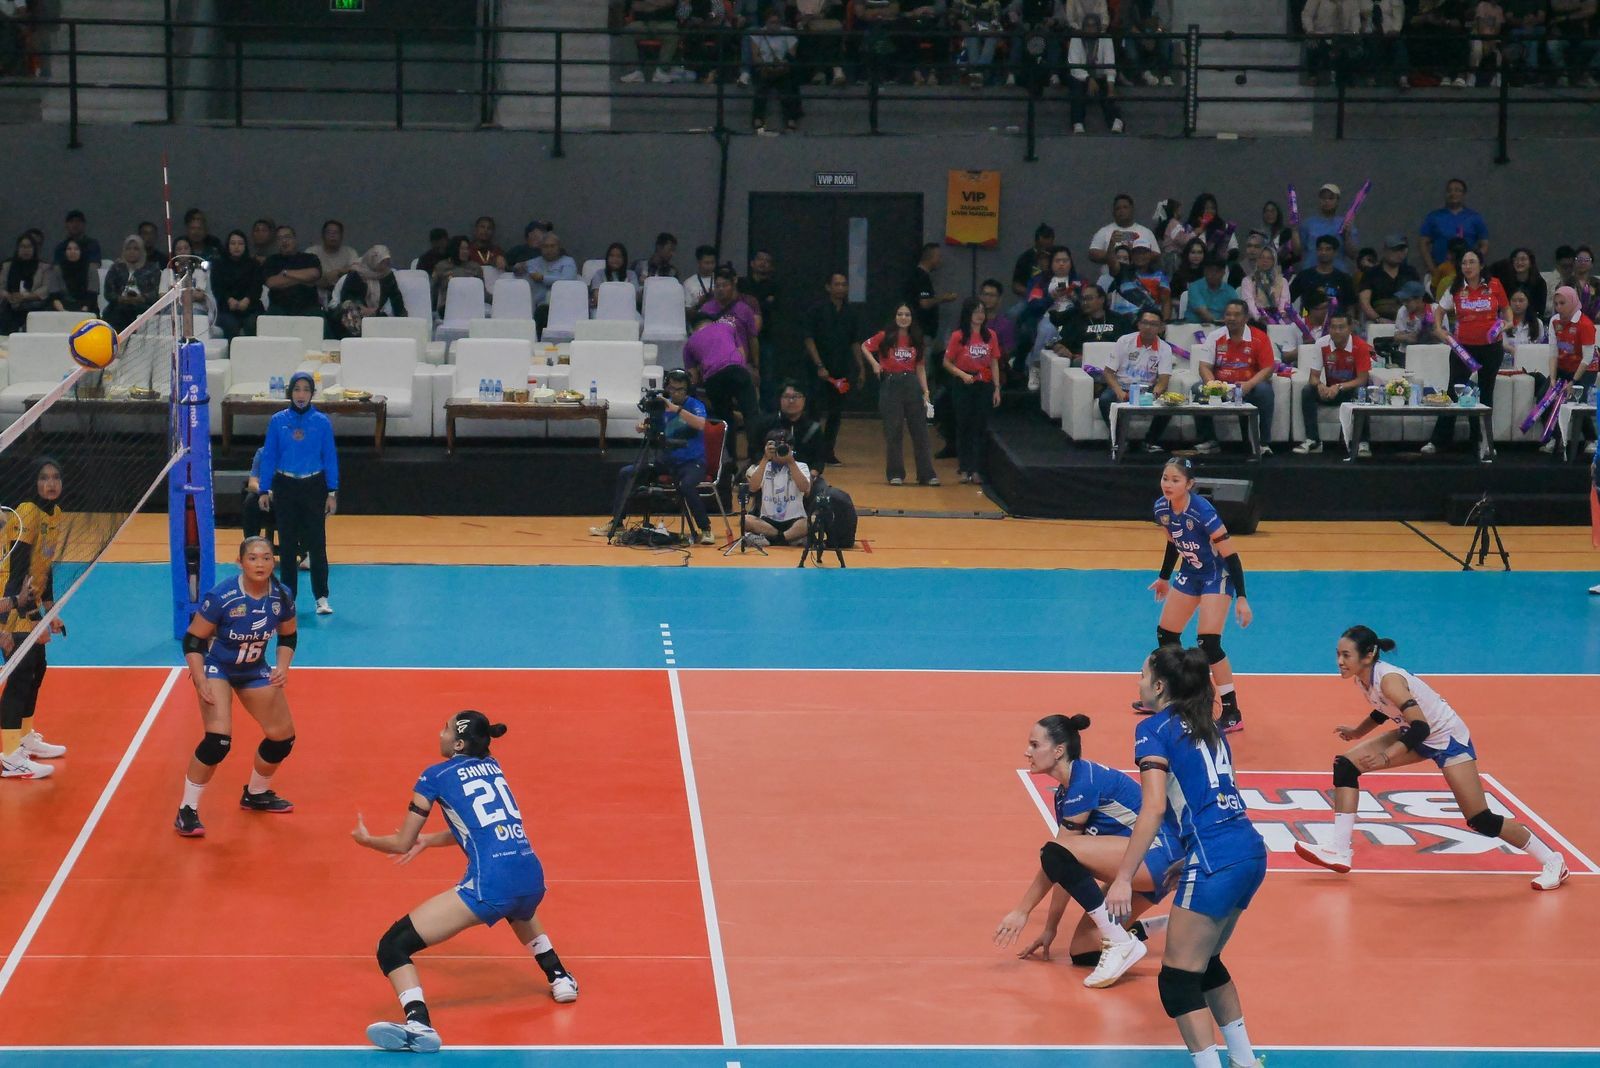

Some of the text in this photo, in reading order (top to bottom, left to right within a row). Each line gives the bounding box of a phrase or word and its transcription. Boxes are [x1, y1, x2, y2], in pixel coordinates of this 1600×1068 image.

[818, 175, 854, 185] VVIP ROOM
[962, 191, 986, 202] VIP
[1086, 324, 1114, 333] KINGS
[190, 394, 199, 428] Snoh
[1182, 541, 1200, 551] bjb
[229, 629, 260, 641] bank
[235, 641, 265, 665] 16
[1195, 738, 1235, 789] 14
[462, 776, 522, 828] 20
